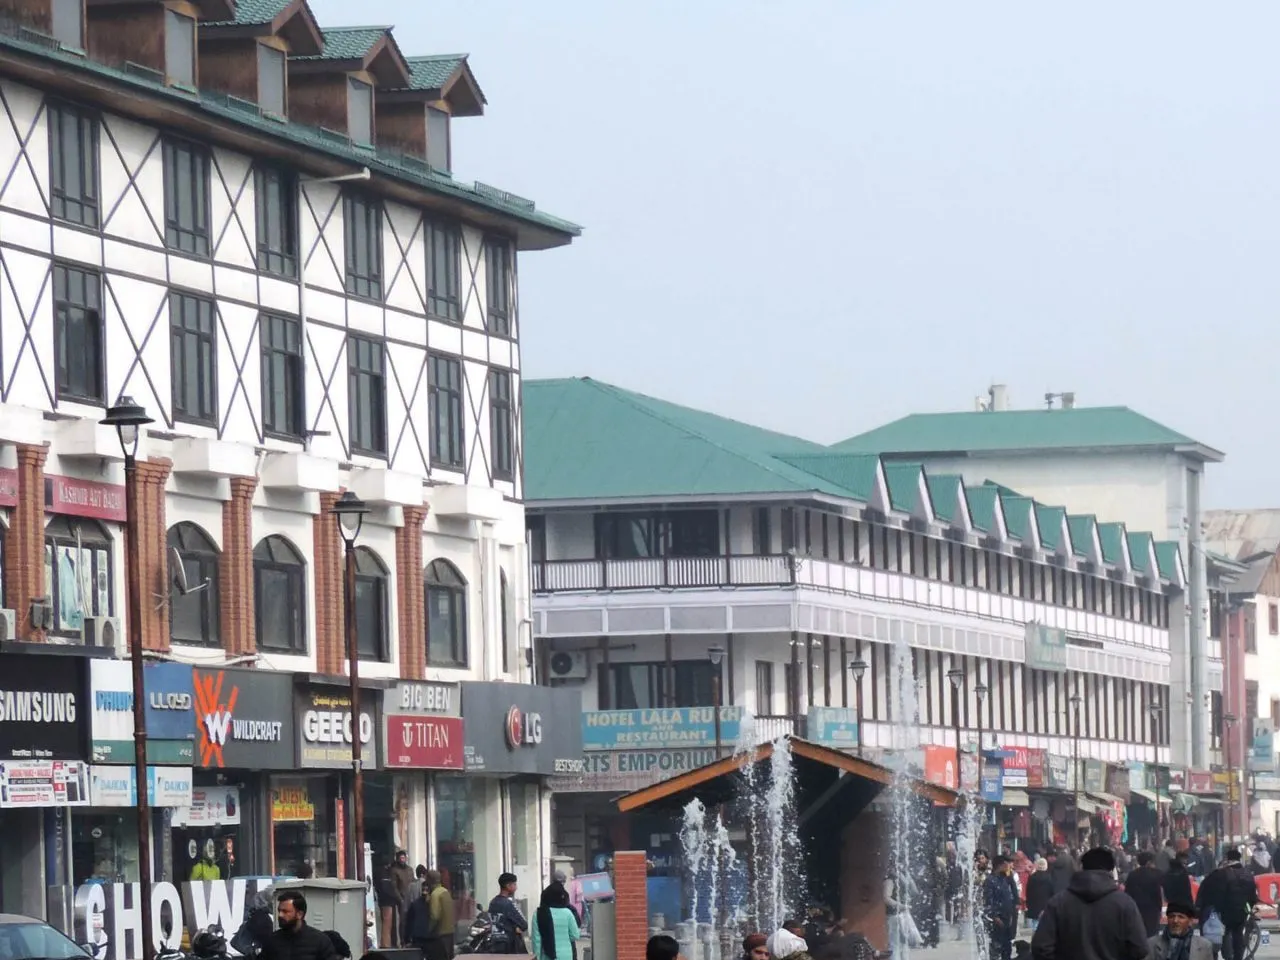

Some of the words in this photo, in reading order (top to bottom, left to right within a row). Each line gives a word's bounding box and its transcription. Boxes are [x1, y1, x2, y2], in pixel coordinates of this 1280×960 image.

[90, 486, 101, 507] ART
[0, 690, 76, 722] SAMSUNG
[95, 690, 134, 711] PHILIP
[150, 692, 191, 710] LLOYD
[402, 685, 422, 708] BIG
[427, 686, 451, 709] BEN
[525, 712, 542, 744] LG
[587, 712, 635, 727] HOTEL
[641, 709, 683, 725] LALA
[232, 719, 282, 741] WILDCRAFT
[415, 722, 449, 748] TITAN
[617, 730, 708, 742] RESTAURANT
[100, 779, 128, 791] DAIKIN
[164, 780, 190, 791] DAIKIN
[76, 879, 273, 960] CHOW
